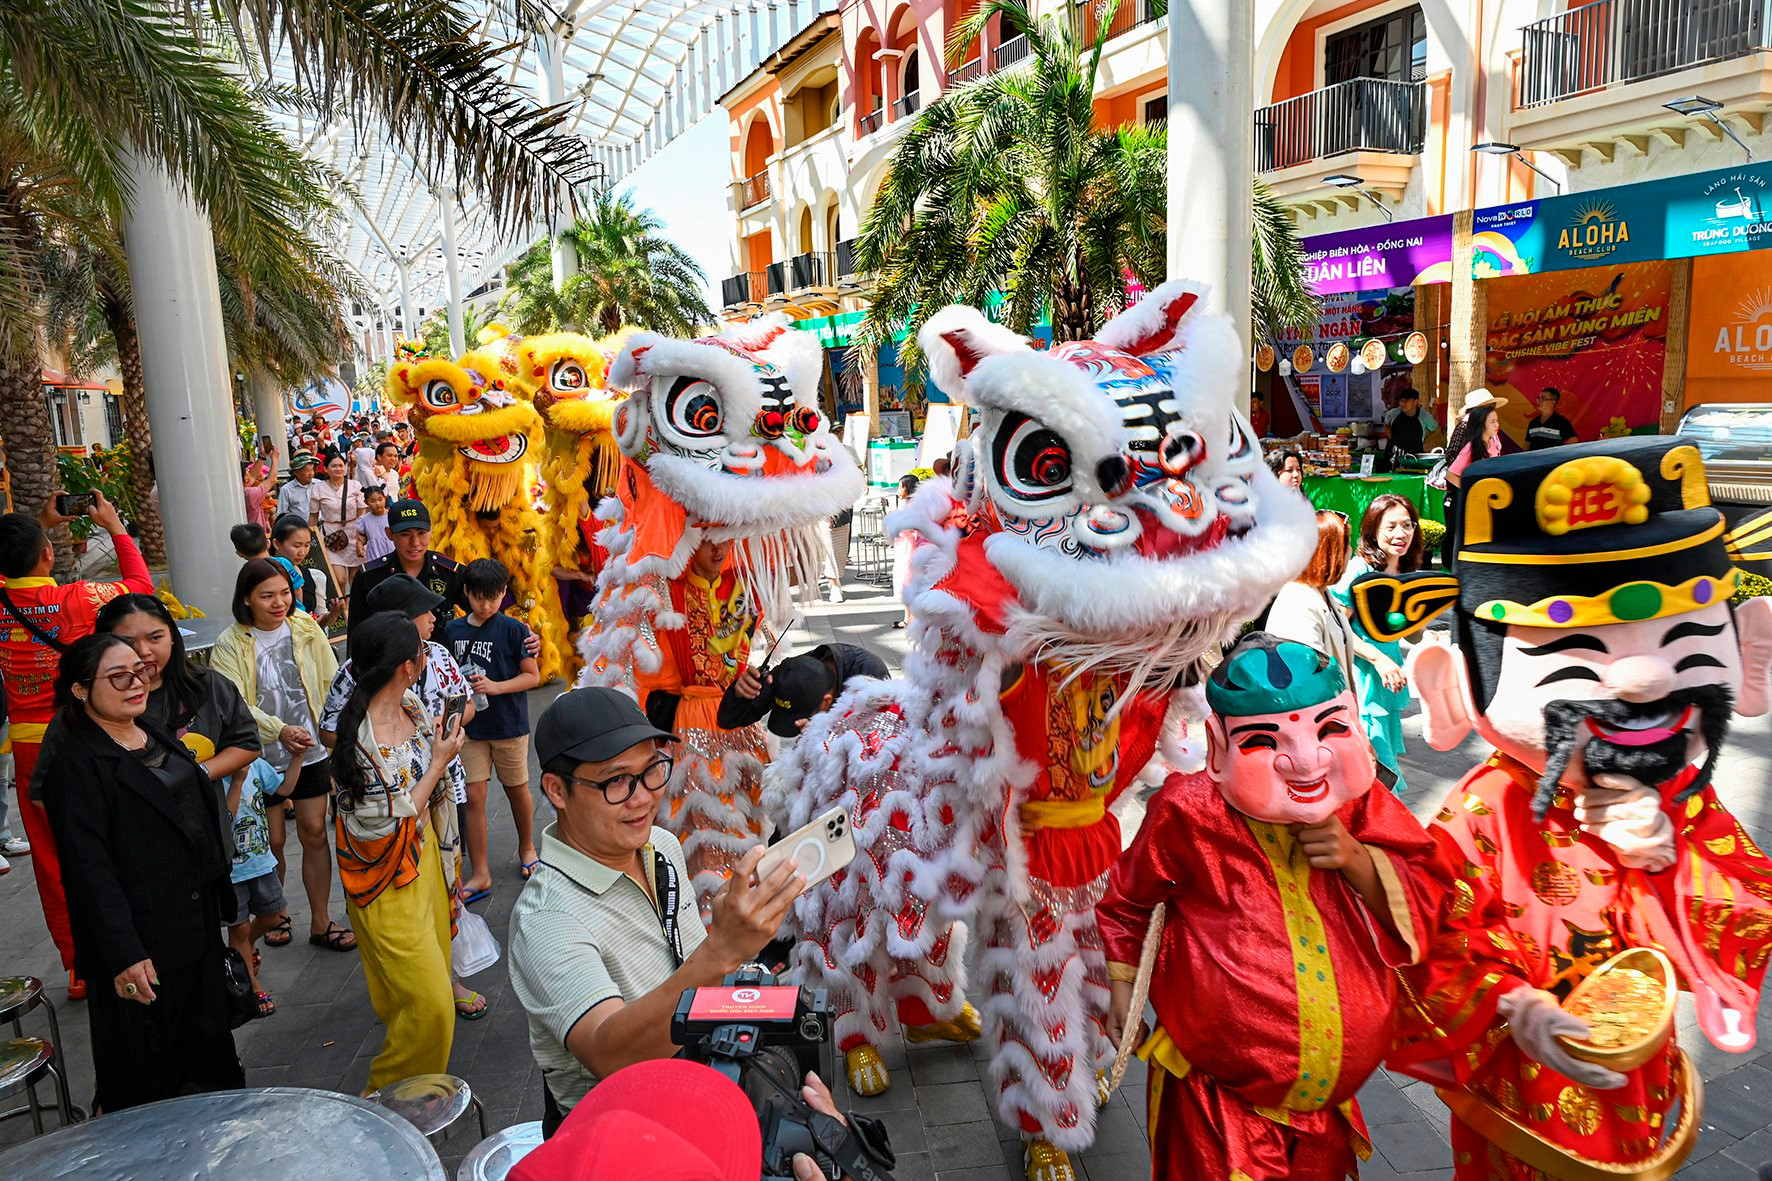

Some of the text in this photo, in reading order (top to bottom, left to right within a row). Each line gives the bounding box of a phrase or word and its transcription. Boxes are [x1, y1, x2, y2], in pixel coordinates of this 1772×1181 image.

[1558, 221, 1629, 249] ALOHA
[1329, 246, 1348, 258] BIÊN
[1350, 243, 1370, 255] HÒA
[1406, 236, 1423, 247] NAI
[1569, 248, 1593, 256] BEACH
[1347, 255, 1386, 279] LIÊN
[1319, 316, 1363, 338] NGÂN
[1505, 335, 1598, 359] CUISINE VIBE FEST
[1729, 354, 1764, 363] BEACH
[401, 509, 418, 518] KGS
[454, 639, 493, 663] CONERSE
[667, 891, 676, 915] PUMA
